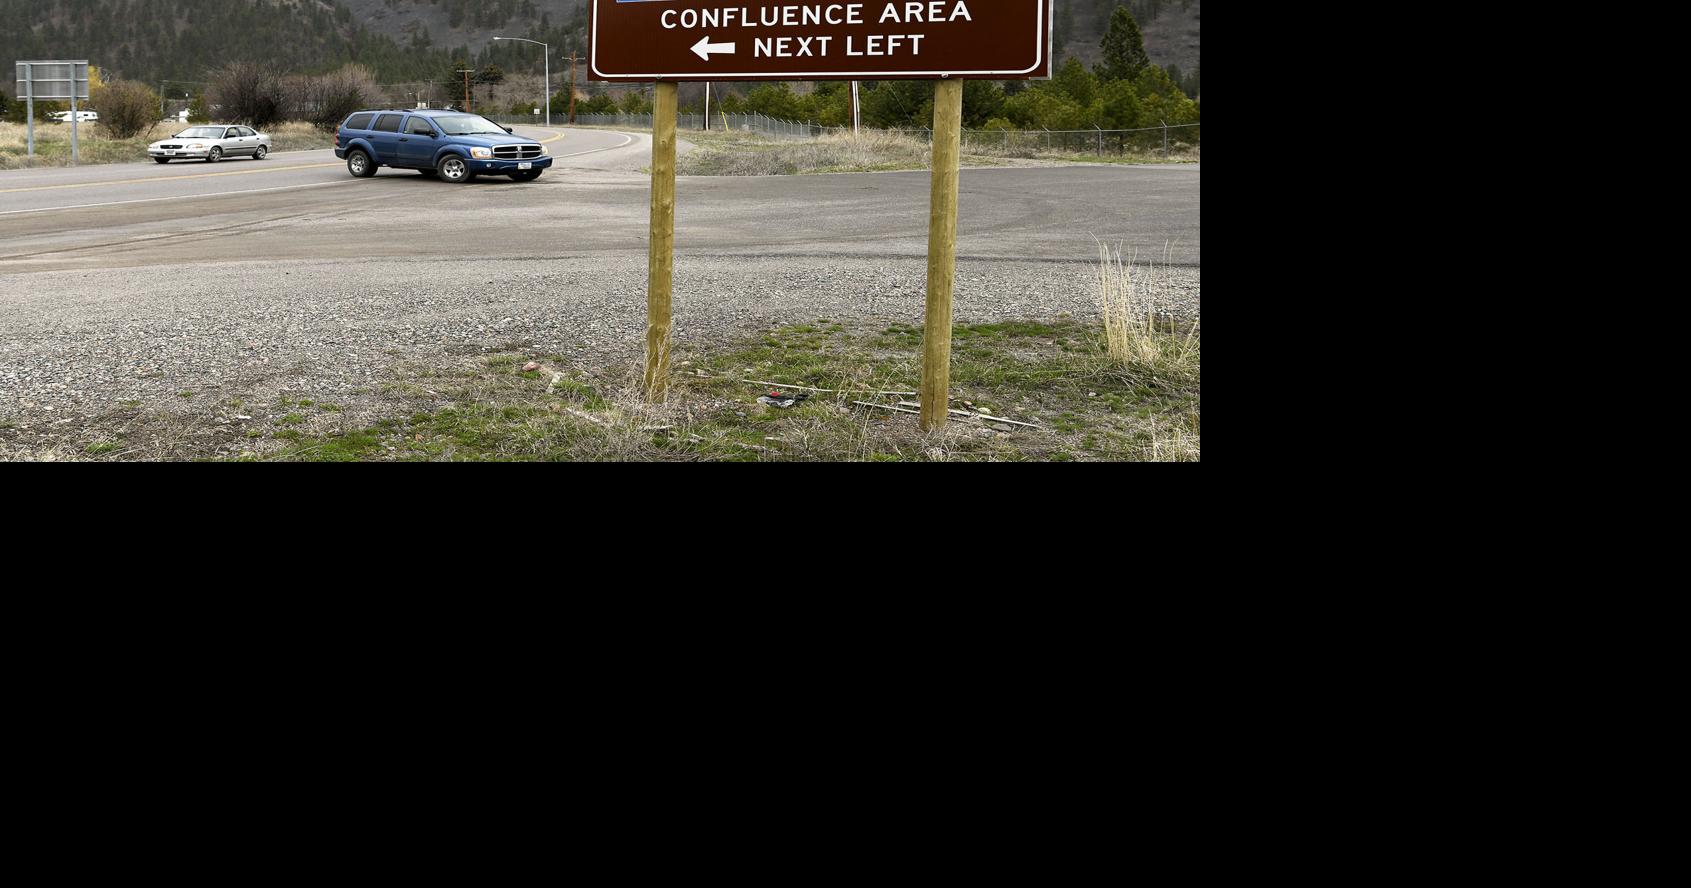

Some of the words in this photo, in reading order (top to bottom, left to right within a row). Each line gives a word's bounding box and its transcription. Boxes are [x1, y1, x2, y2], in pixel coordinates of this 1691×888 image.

[660, 3, 865, 29] CONFLUENCE
[878, 1, 972, 24] AREA
[754, 36, 833, 58] NEXT
[846, 34, 926, 57] LEFT
